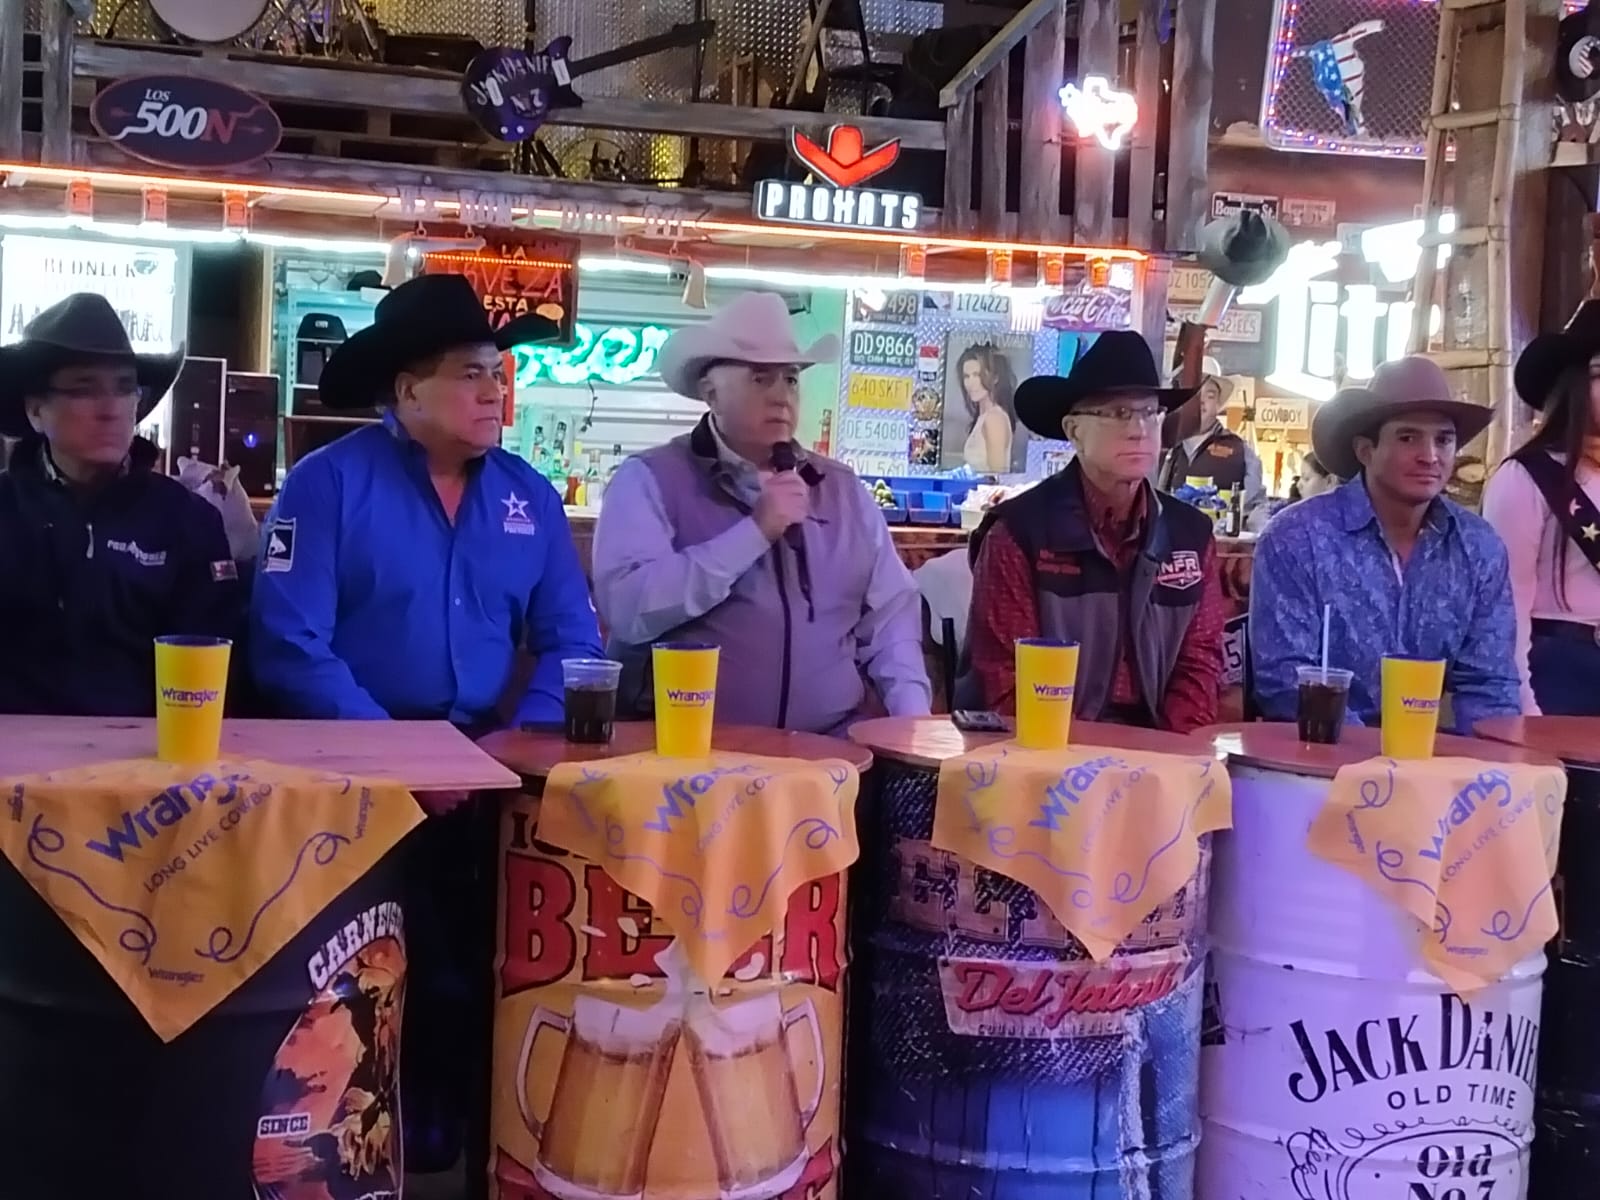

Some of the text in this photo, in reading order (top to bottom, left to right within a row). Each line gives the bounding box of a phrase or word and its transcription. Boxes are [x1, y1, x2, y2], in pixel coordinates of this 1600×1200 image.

[144, 89, 171, 101] LOS
[112, 101, 245, 145] 500N
[765, 183, 919, 229] PROHATS
[501, 244, 527, 260] LA
[483, 295, 529, 312] ESTA
[1161, 556, 1198, 574] NFR
[143, 856, 187, 893] LONG
[186, 828, 219, 859] LIVE
[953, 962, 1053, 1017] Del
[1288, 1014, 1429, 1103] JACK
[1387, 1083, 1517, 1110] OLD TIME
[260, 1116, 308, 1135] SINCE
[1416, 1143, 1494, 1179] Old
